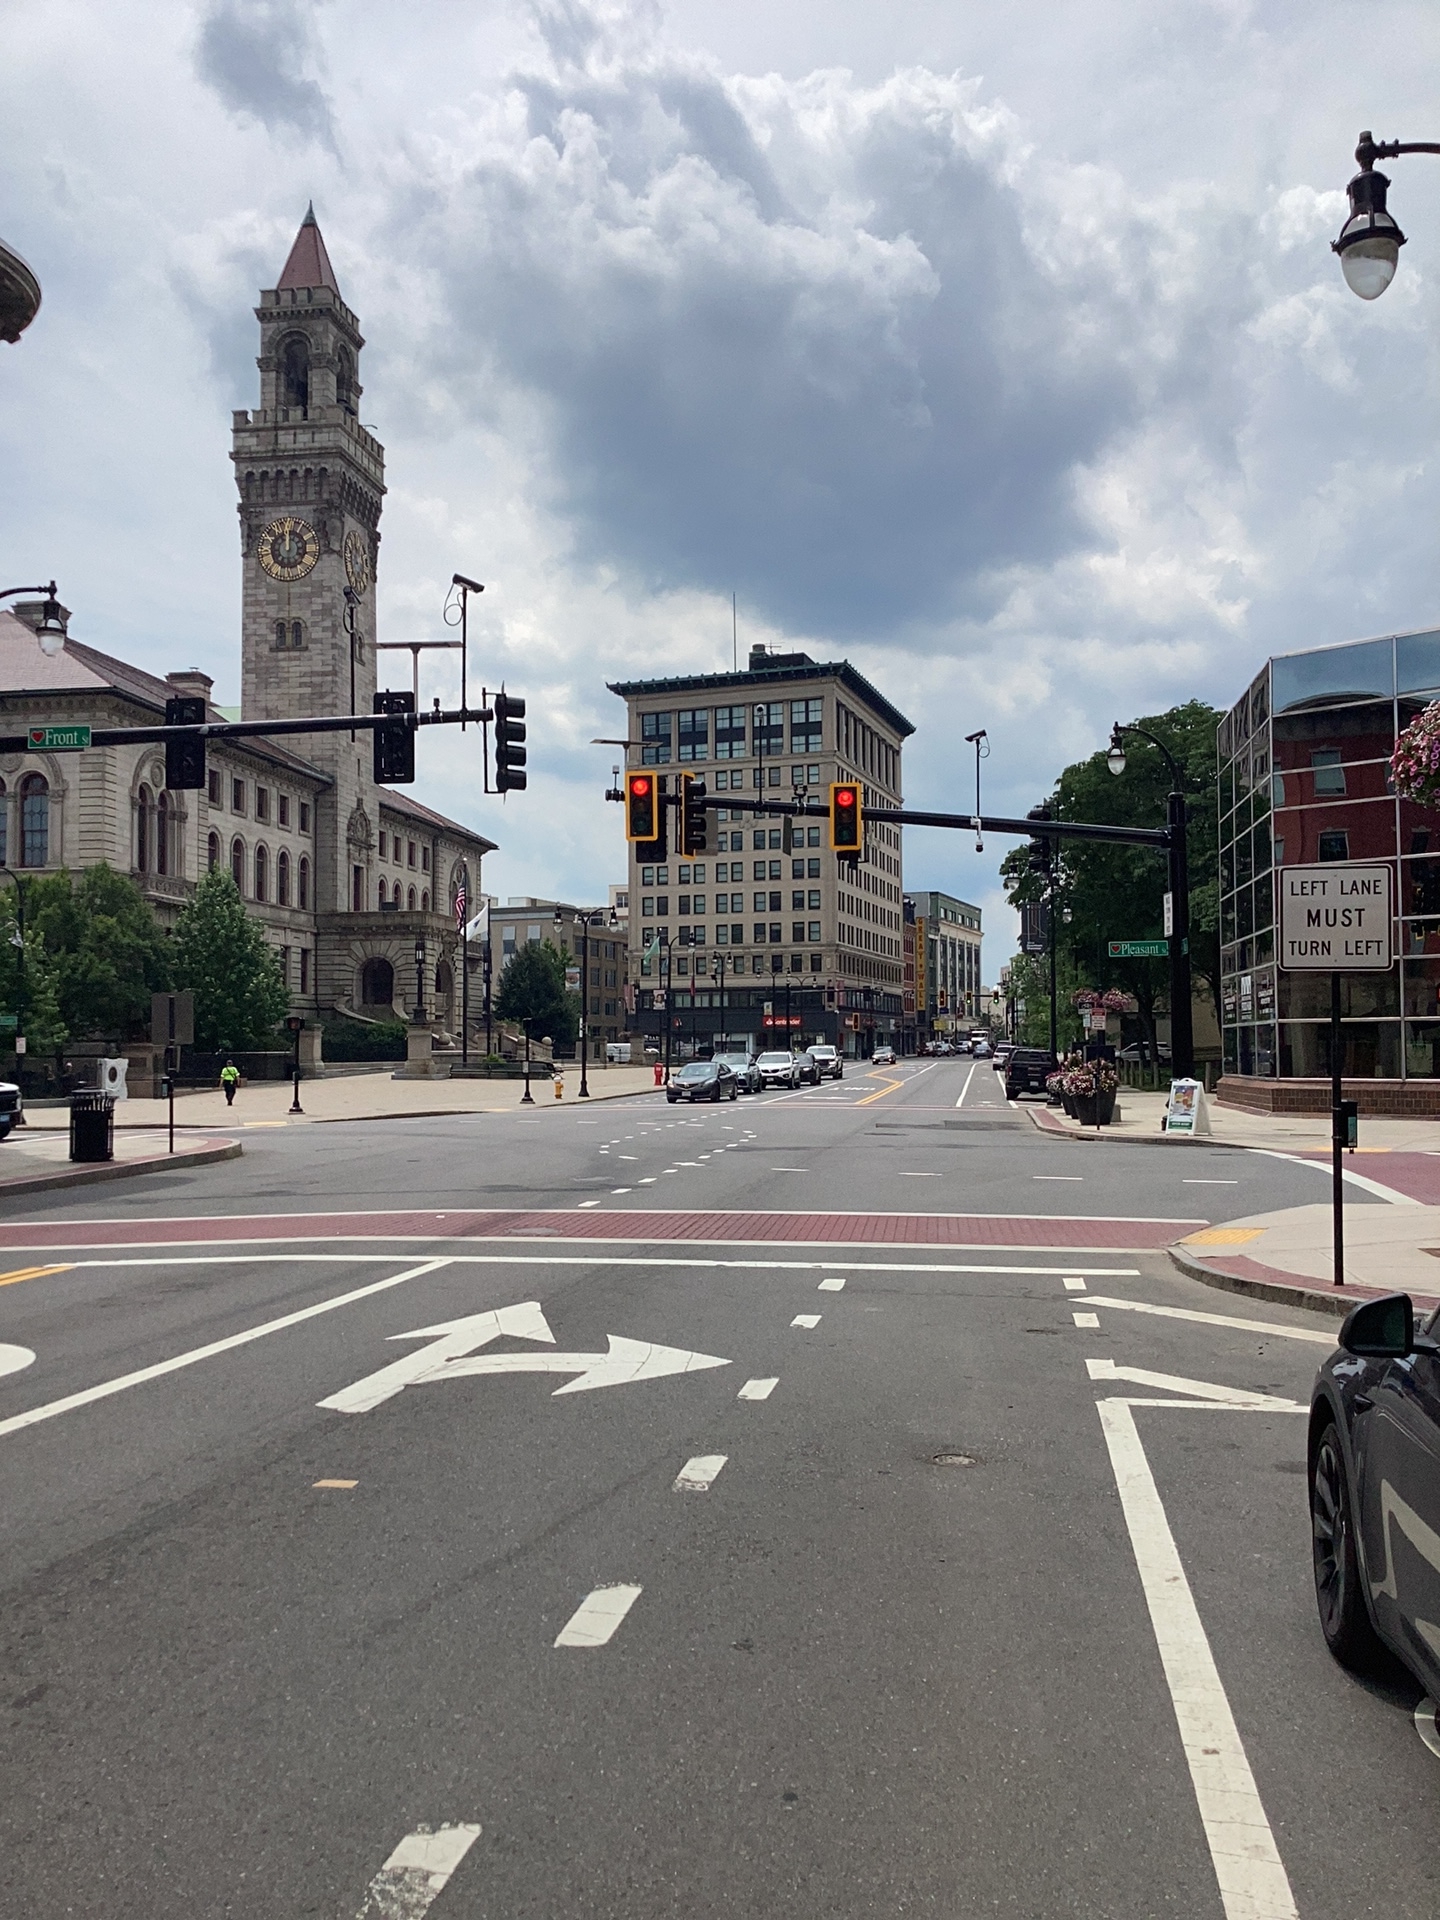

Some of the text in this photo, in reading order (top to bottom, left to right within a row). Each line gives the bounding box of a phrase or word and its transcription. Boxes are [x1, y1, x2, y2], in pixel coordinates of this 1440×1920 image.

[45, 729, 78, 745] Front
[1290, 880, 1382, 896] LEFT LANE
[1307, 908, 1365, 928] MUST
[1121, 943, 1159, 955] Pleasant
[1288, 940, 1383, 956] TURN LEFT
